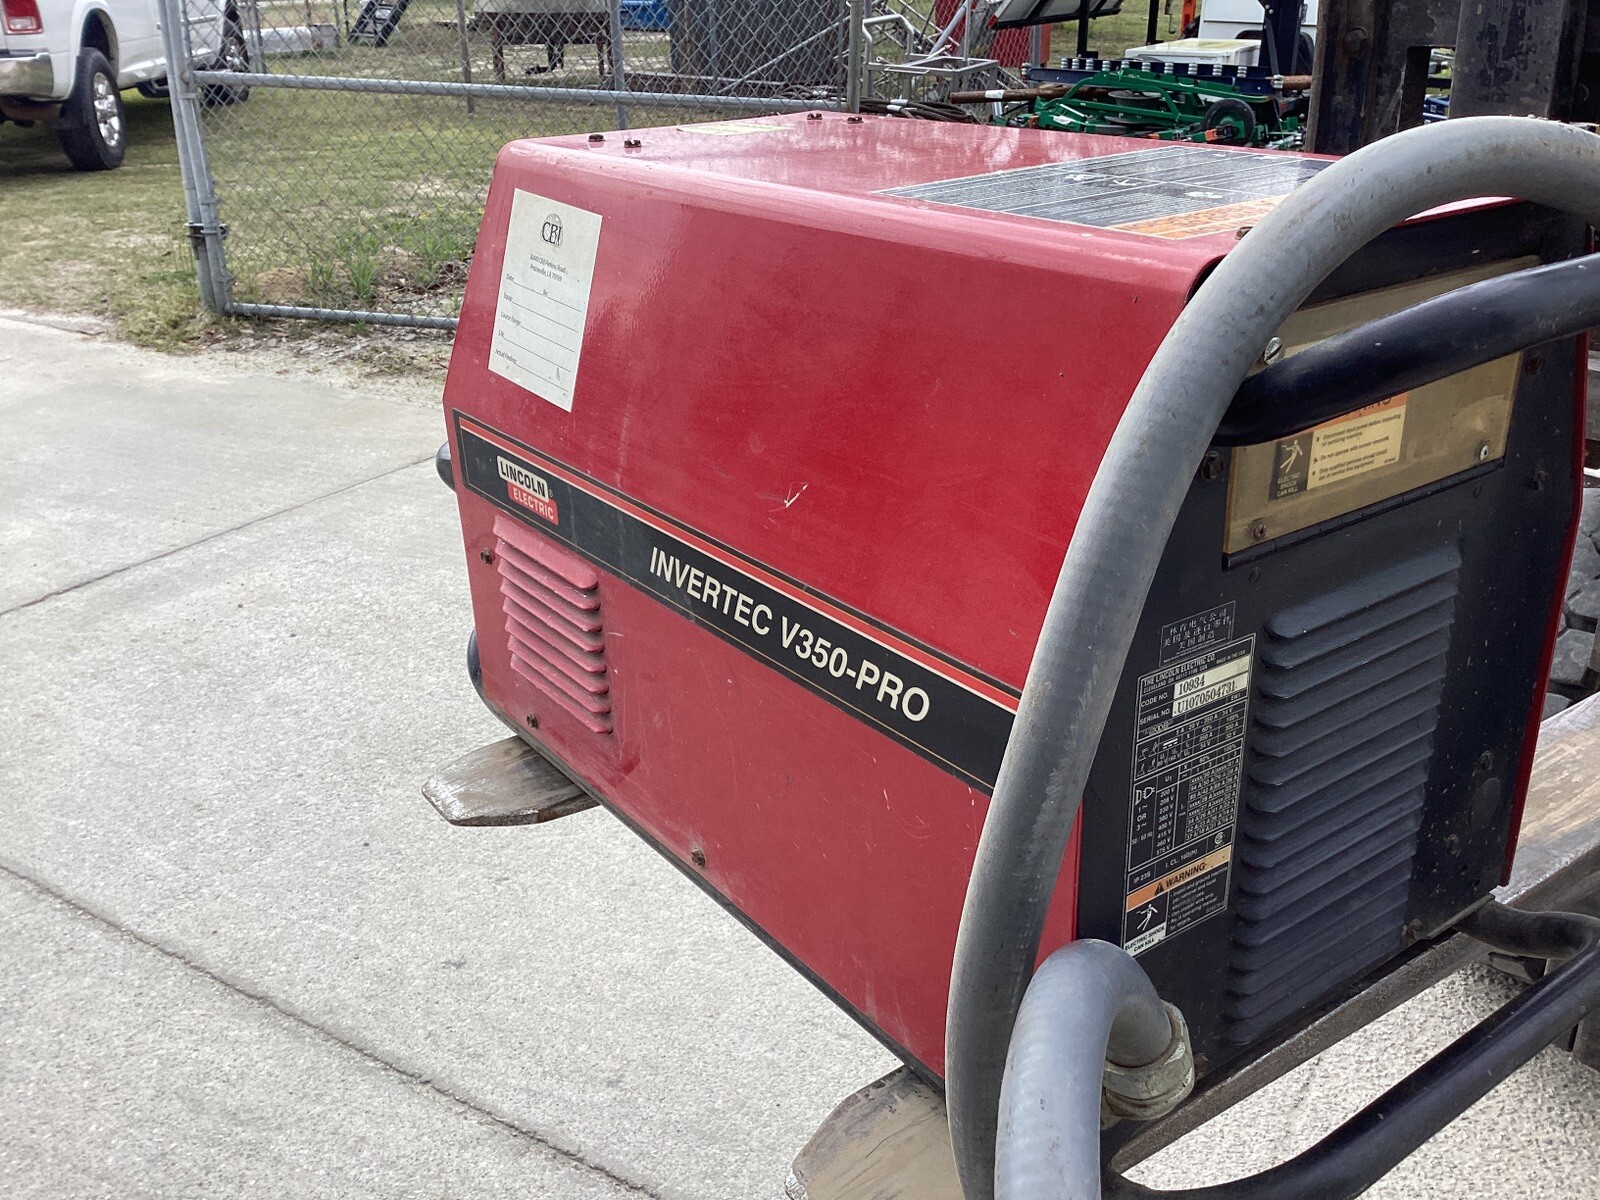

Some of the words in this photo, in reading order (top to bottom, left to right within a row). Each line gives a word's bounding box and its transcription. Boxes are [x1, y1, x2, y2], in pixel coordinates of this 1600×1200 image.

[500, 460, 546, 498] LINCOLN
[512, 486, 554, 520] ELECTRIC
[650, 547, 773, 635] INVERTEC
[781, 616, 930, 722] V350-PRO
[1144, 676, 1155, 687] THE
[1156, 666, 1180, 682] LINCOLN
[1181, 656, 1207, 672] ELECTRIC
[1141, 696, 1158, 707] CODE
[1158, 692, 1168, 701] NO.
[1178, 674, 1205, 695] 10934
[1140, 712, 1160, 725] SERIAL
[1161, 708, 1171, 716] NO.
[1166, 862, 1206, 887] WARNING
